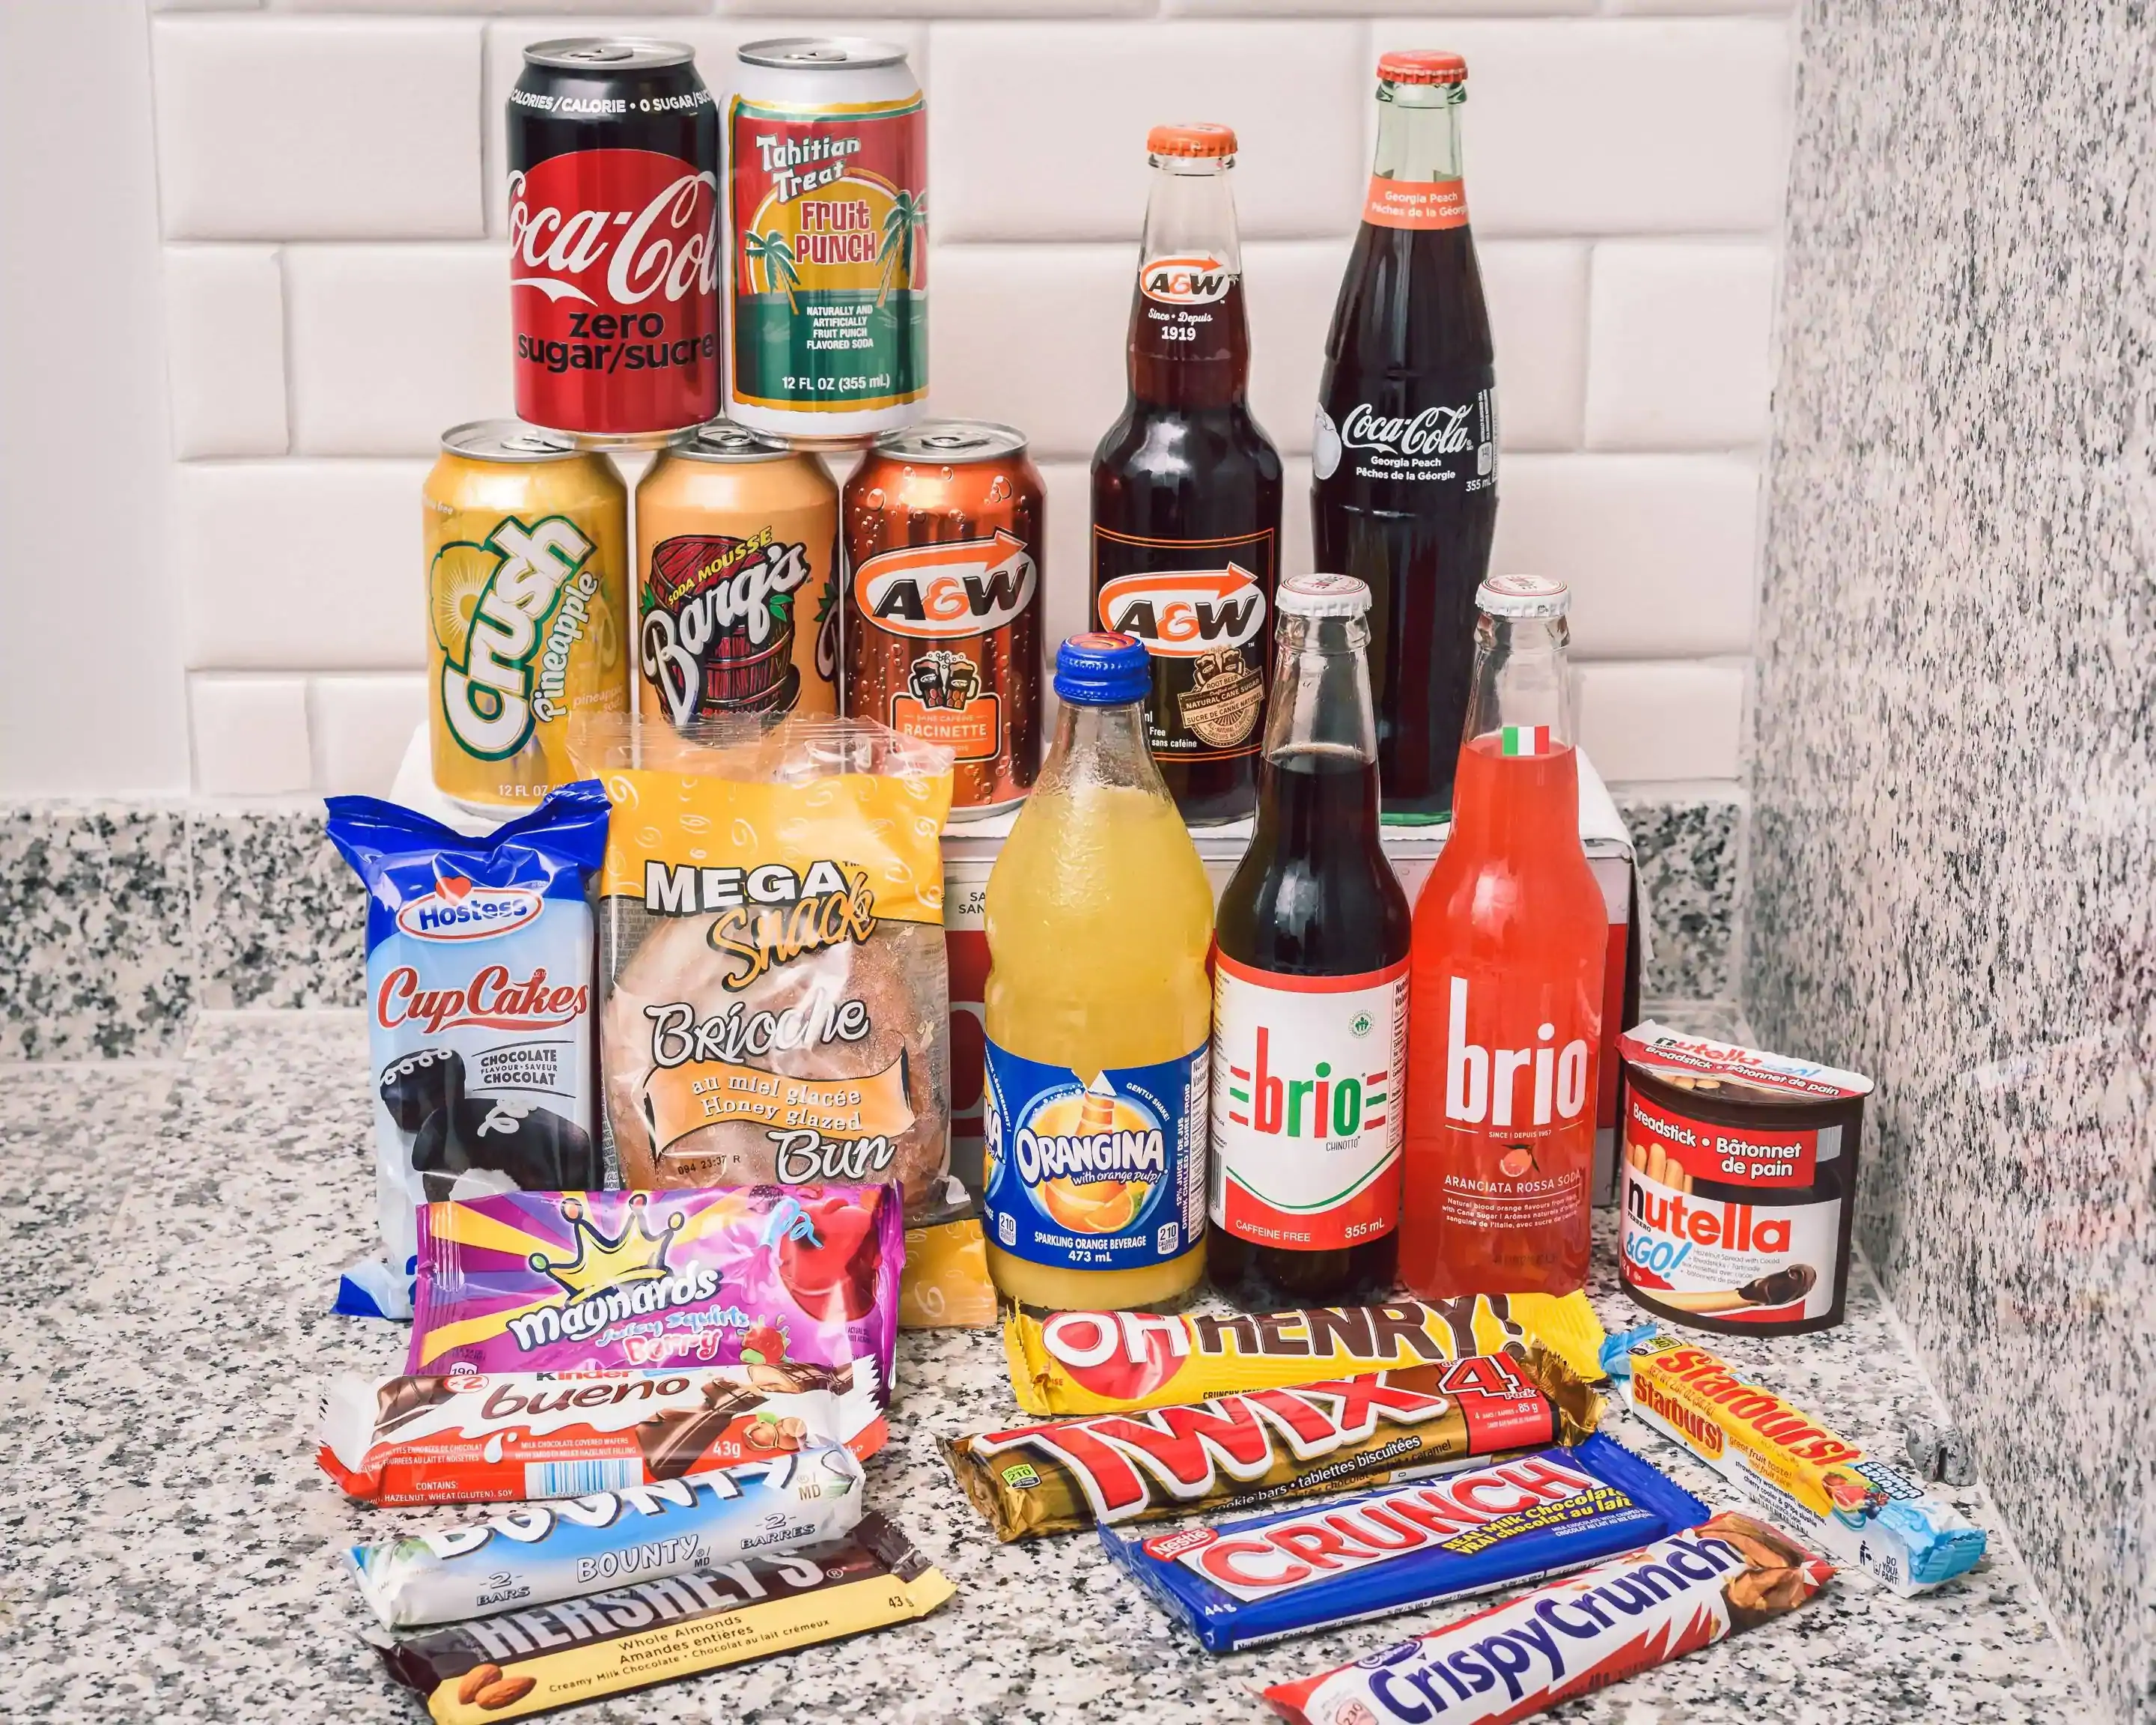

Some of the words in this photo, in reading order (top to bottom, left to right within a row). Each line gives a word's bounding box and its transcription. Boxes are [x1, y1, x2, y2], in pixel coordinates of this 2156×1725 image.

[756, 133, 861, 171] Tahitian
[773, 160, 845, 202] Treat
[1386, 191, 1427, 204] Georgia
[801, 201, 870, 231] Fruit
[796, 233, 876, 264] PUNCH
[1148, 273, 1225, 296] A&W
[807, 306, 853, 316] NATURALLY
[856, 305, 873, 314] AND
[813, 317, 867, 326] ARTIFICIALLY
[1148, 308, 1170, 320] Since
[1178, 311, 1213, 326] Depuis
[569, 312, 665, 338] zero
[813, 328, 837, 338] FRUIT
[839, 328, 867, 337] PUNCH
[1161, 326, 1196, 341] 1919
[518, 332, 714, 374] sugar/sucre
[807, 340, 850, 350] FLAVORED
[852, 338, 874, 348] SODA
[782, 377, 795, 389] 12
[800, 377, 814, 389] FL
[817, 377, 835, 389] OZ
[838, 376, 866, 392] (355
[1342, 404, 1473, 454] Coca-Cola
[1356, 467, 1389, 479] Pêches
[1391, 469, 1404, 480] de
[1407, 471, 1416, 480] la
[1418, 471, 1456, 481] Géorgie
[1371, 456, 1410, 467] Georgia
[1412, 457, 1442, 467] Peach
[1466, 479, 1481, 492] 355
[669, 579, 695, 606] SODA
[698, 526, 773, 583] MOUSSE
[873, 563, 1029, 621] A&W
[1114, 594, 1259, 642] A&W
[443, 517, 596, 758] Crush
[532, 571, 599, 723] Pineapple
[642, 544, 806, 728] Barq's
[1186, 697, 1220, 710] NATURAL
[1221, 688, 1240, 699] CANE
[1187, 713, 1208, 723] SUCRE
[1219, 703, 1240, 715] CANNE
[904, 723, 987, 737] RACINETTE
[1149, 726, 1166, 737] Free
[1151, 739, 1168, 748] sans
[499, 785, 513, 796] 12
[516, 785, 530, 797] FL
[645, 860, 850, 915] MEGA
[418, 900, 527, 931] Hostess
[708, 872, 876, 991] Snack
[481, 1049, 556, 1067] CHOCOLATE
[1446, 976, 1588, 1126] brio
[1654, 1037, 1762, 1066] nutella
[481, 1065, 519, 1074] FLAVOUR
[525, 1063, 558, 1072] SAVEUR
[484, 1071, 555, 1086] CHOCOLAT
[1645, 1046, 1713, 1070] Breadstick
[1788, 1074, 1805, 1087] de
[1807, 1081, 1839, 1096] pain
[692, 1076, 719, 1093] au
[728, 1074, 779, 1098] miel
[786, 1086, 862, 1107] glacée
[1254, 1026, 1362, 1138] brio
[702, 1096, 779, 1120] Honey
[786, 1109, 862, 1131] glazed
[1126, 1083, 1152, 1102] GENTLY
[1151, 1098, 1170, 1122] SHAKE!
[1633, 1103, 1696, 1148] Breadstick
[1715, 1137, 1802, 1160] Bâtonnet
[767, 1130, 896, 1184] Bun
[1016, 1129, 1164, 1183] ORANGINA
[1326, 1140, 1359, 1151] CHINOTTO
[1073, 1172, 1095, 1185] with
[1097, 1172, 1133, 1184] orange
[1445, 1175, 1512, 1193] ARANCIATA
[1517, 1179, 1555, 1193] ROSSA
[1557, 1169, 1581, 1187] SODA
[1721, 1160, 1746, 1175] de
[1751, 1160, 1793, 1180] pain
[1496, 1204, 1522, 1212] orange
[1628, 1177, 1791, 1253] nutella
[1000, 1215, 1014, 1232] 210
[1160, 1225, 1177, 1236] 210
[1236, 1220, 1280, 1240] CAFFEINE
[1283, 1232, 1311, 1242] FREE
[1345, 1224, 1367, 1239] 355
[1369, 1217, 1385, 1234] mL
[1627, 1211, 1651, 1233] FERRERO
[1035, 1231, 1074, 1248] SPARKLING
[1075, 1238, 1109, 1250] ORANGE
[1109, 1235, 1146, 1249] BEVERAGE
[1068, 1252, 1091, 1262] 473
[1094, 1252, 1112, 1262] mL
[1626, 1232, 1693, 1279] &GO!
[1442, 1354, 1515, 1395] 4
[481, 1378, 690, 1420] bueno
[1517, 1403, 1529, 1413] 85
[1656, 1350, 1862, 1466] Starburst
[1633, 1372, 1723, 1454] Starburst
[538, 1440, 573, 1448] CHOCOLATE
[713, 1440, 740, 1458] 43g
[976, 1370, 1446, 1517] TWIX
[1412, 1440, 1452, 1463] caramel
[1258, 1485, 1287, 1501] bars
[1298, 1461, 1356, 1487] tablettes
[1357, 1435, 1421, 1470] biscuitées
[1749, 1448, 1767, 1465] fruit
[1008, 1469, 1032, 1481] 210
[1735, 1461, 1762, 1483] strawberry
[1856, 1464, 1907, 1500] SPLASH
[1868, 1461, 1923, 1498] SUMMER
[416, 1481, 458, 1491] CONTAINS:
[428, 1492, 457, 1500] WHEAT
[740, 1524, 815, 1549] BARRES
[1201, 1461, 1592, 1587] CRUNCH
[1443, 1527, 1484, 1551] REAL
[1484, 1512, 1525, 1534] Milk
[1457, 1536, 1496, 1555] VRAI
[1498, 1511, 1568, 1539] chocolat
[1571, 1506, 1592, 1519] au
[1596, 1497, 1633, 1514] lait
[1151, 1529, 1209, 1554] Nestlé
[577, 1534, 698, 1583] BOUNTY
[466, 1548, 823, 1659] HERSHEYS
[477, 1586, 530, 1607] BARS
[889, 1596, 903, 1607] 43
[1205, 1605, 1222, 1616] 44
[618, 1632, 668, 1651] Whole
[674, 1614, 742, 1636] Almonds
[620, 1640, 689, 1664] Amandes
[694, 1625, 753, 1646] entières
[549, 1678, 592, 1693] Creamy
[597, 1670, 619, 1682] Milk
[622, 1656, 680, 1676] Chocolate
[692, 1641, 743, 1658] Chocolat
[746, 1637, 758, 1646] au
[760, 1631, 779, 1642] lait
[782, 1619, 829, 1635] crémeux
